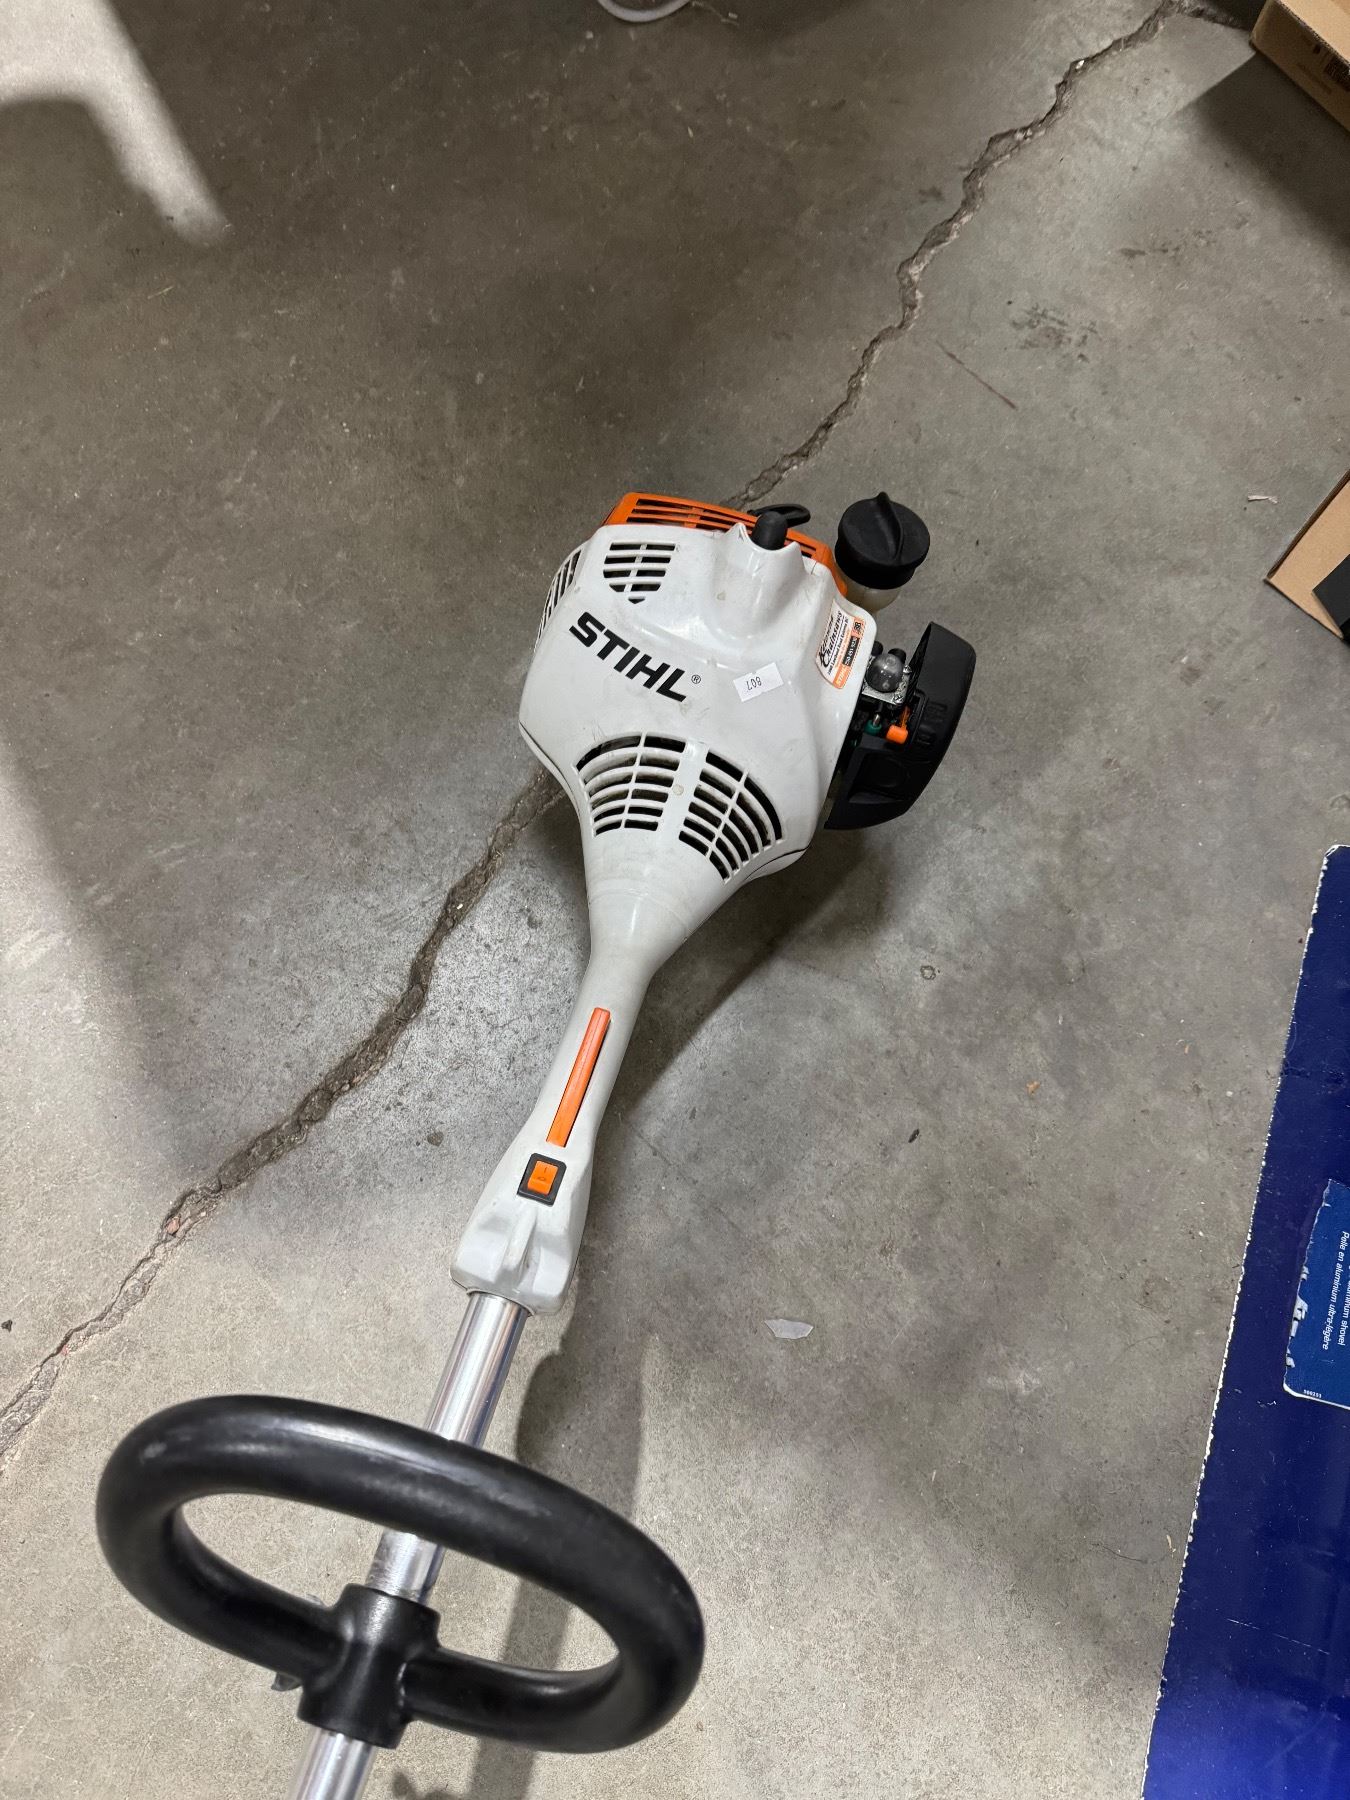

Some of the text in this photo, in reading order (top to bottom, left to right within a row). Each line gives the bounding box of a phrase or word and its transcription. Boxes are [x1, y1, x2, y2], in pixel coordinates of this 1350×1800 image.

[569, 611, 686, 702] STIHL
[822, 610, 842, 667] Chainsaws
[746, 676, 762, 690] 807
[1338, 1251, 1344, 1262] en
[1330, 1262, 1343, 1303] aluminium
[1323, 1304, 1337, 1350] ultra-légère
[1338, 1320, 1348, 1346] shovel
